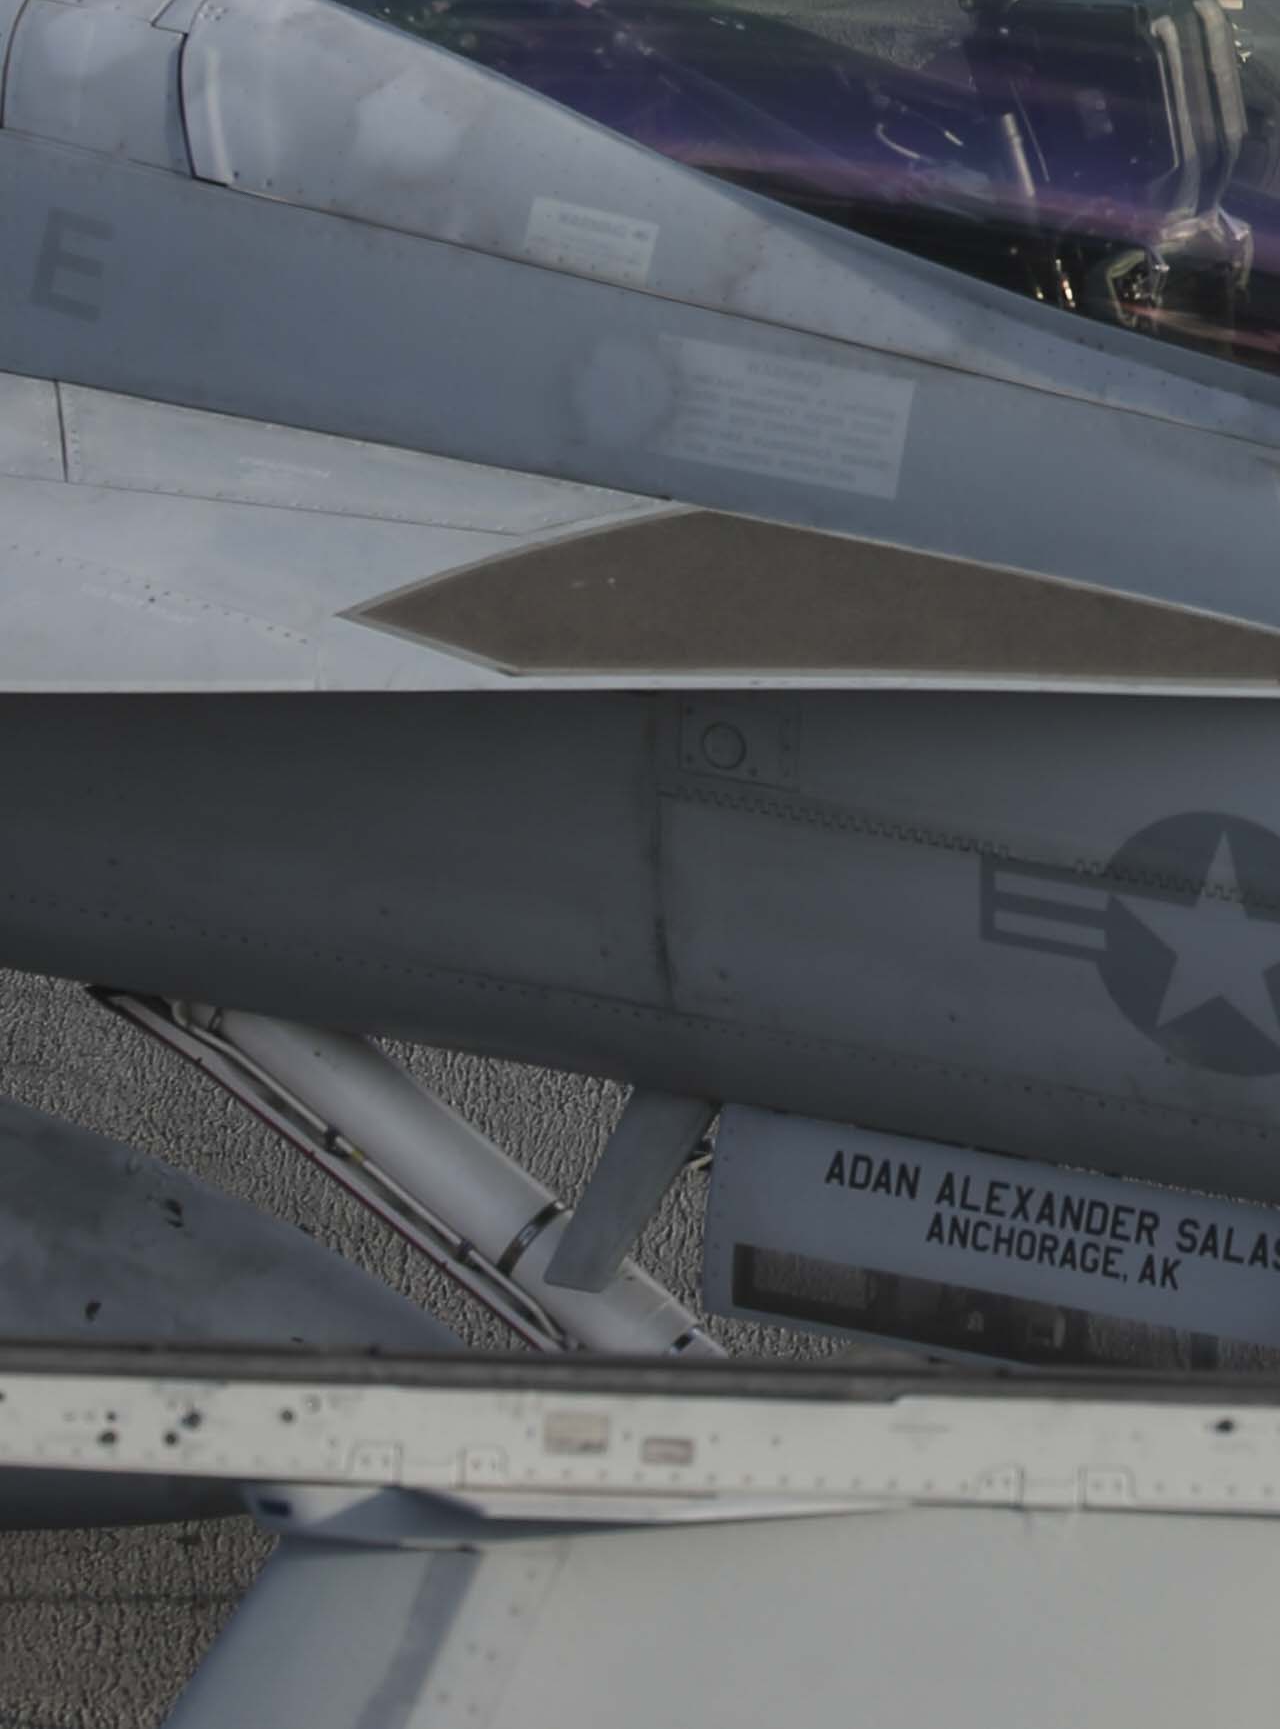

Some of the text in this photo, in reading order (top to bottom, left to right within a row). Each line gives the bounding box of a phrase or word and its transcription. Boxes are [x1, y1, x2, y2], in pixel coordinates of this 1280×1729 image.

[29, 206, 115, 323] E
[824, 1149, 921, 1200] ADAN
[935, 1171, 1160, 1247] ALEXANDER
[926, 1212, 1183, 1291] ANCHORAGE, AK
